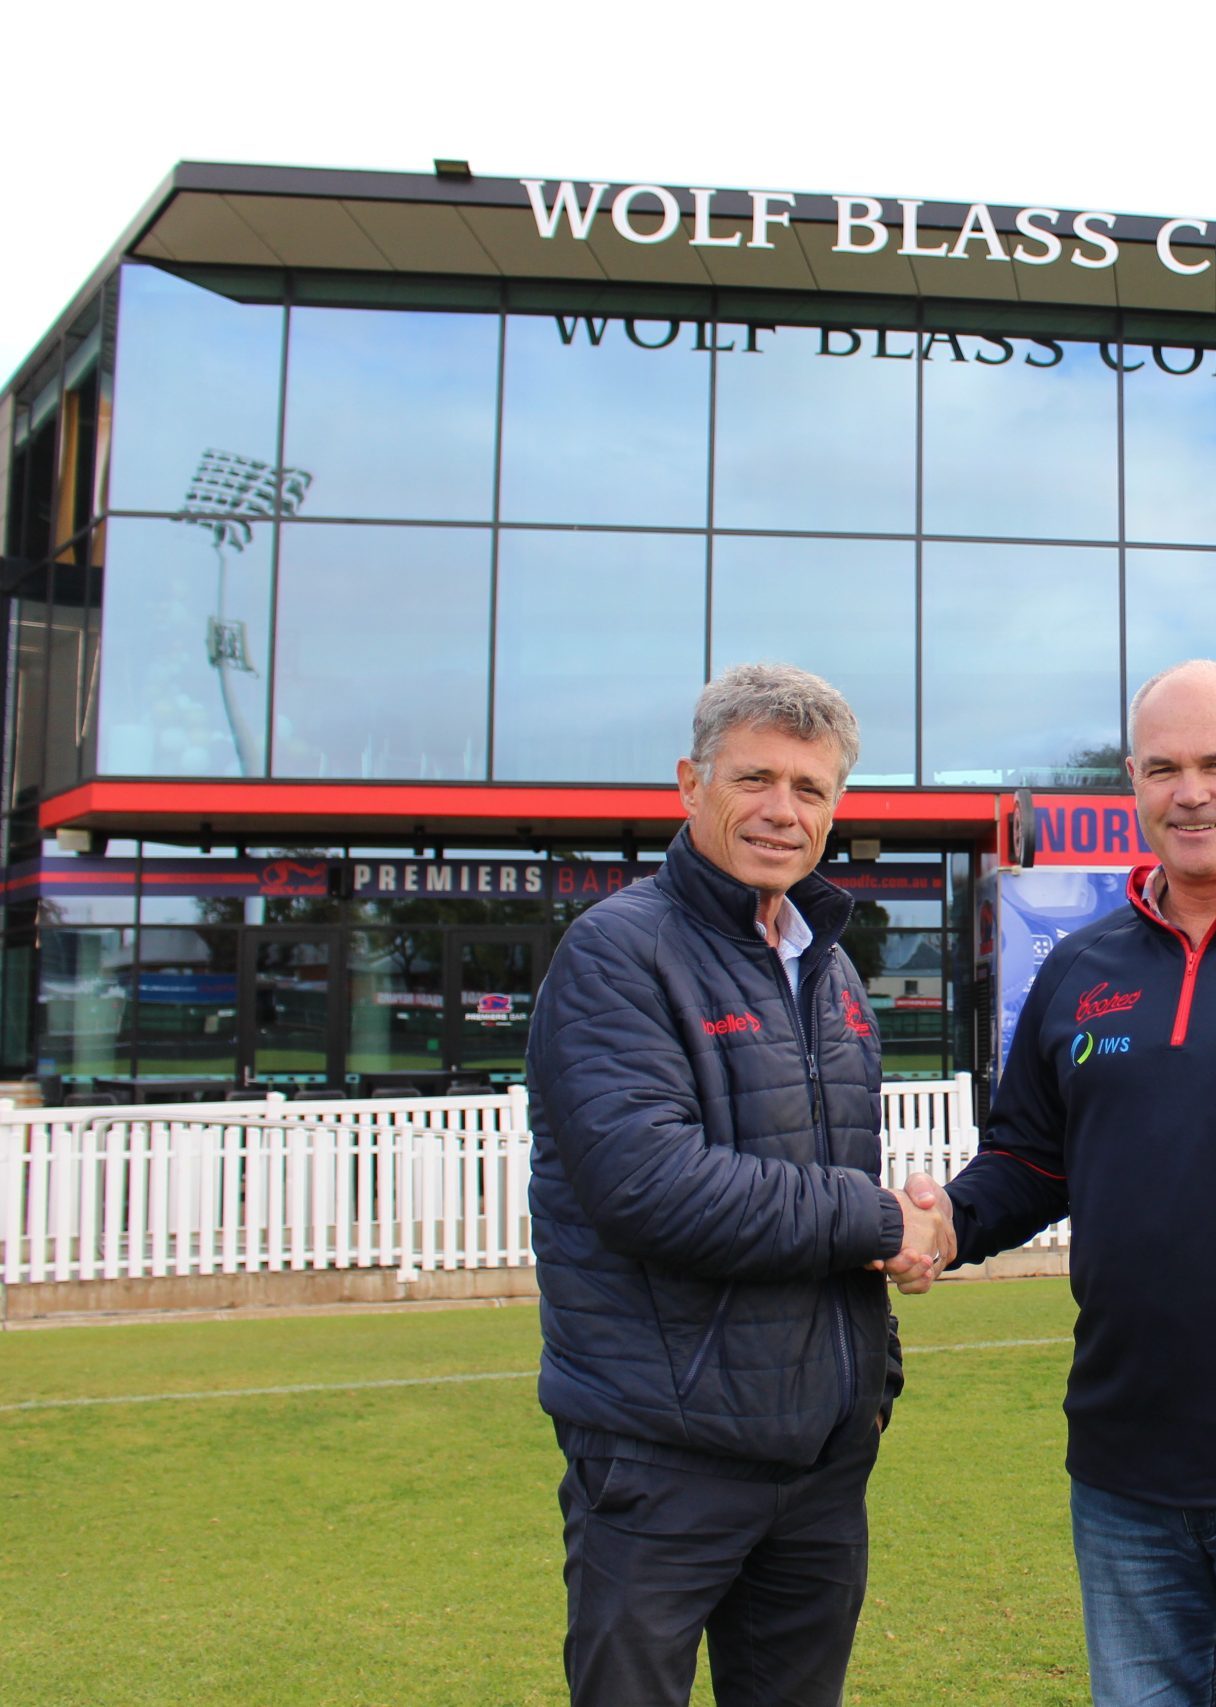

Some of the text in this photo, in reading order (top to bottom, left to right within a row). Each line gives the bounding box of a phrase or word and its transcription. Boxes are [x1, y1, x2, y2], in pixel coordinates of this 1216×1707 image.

[519, 178, 797, 249] WOLF
[832, 195, 1120, 270] BLASS
[353, 864, 625, 893] PREMIERS BAR
[1097, 1036, 1131, 1055] IWS
